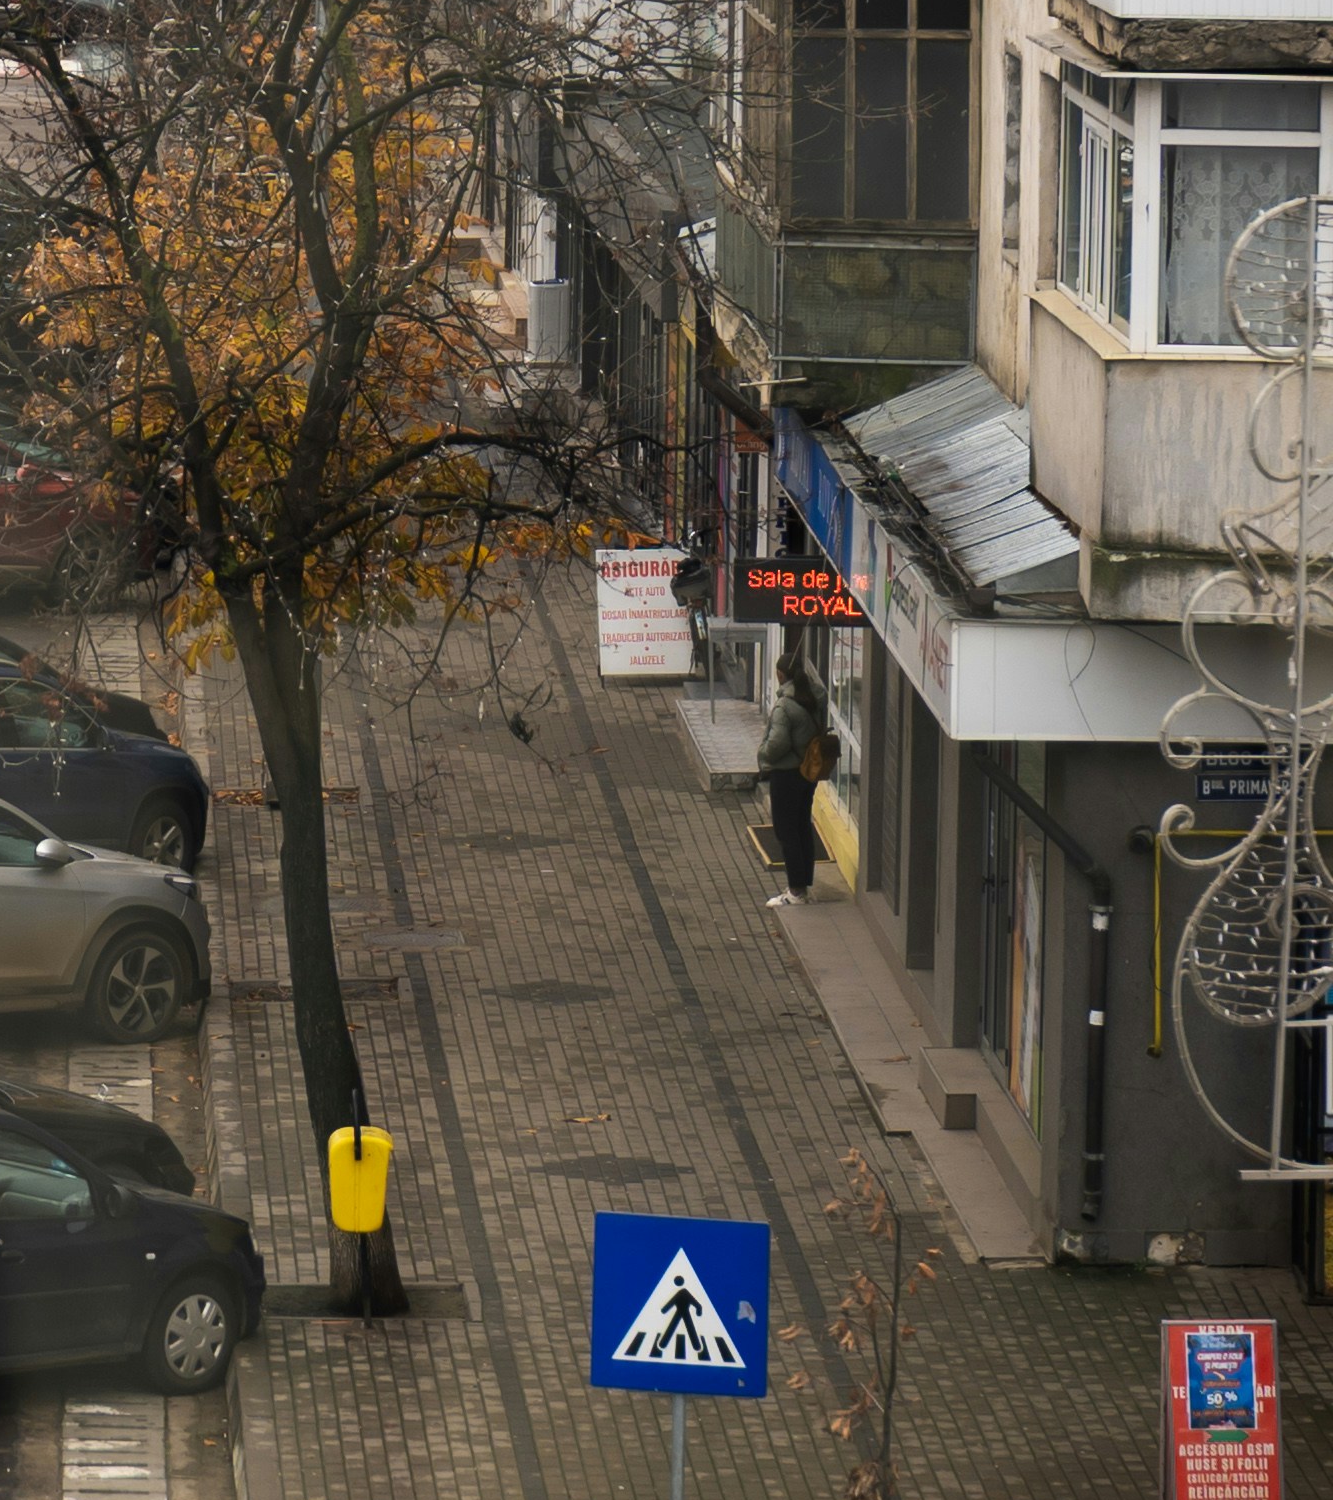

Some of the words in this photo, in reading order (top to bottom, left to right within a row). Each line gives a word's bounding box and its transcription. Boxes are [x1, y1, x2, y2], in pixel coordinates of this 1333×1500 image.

[748, 569, 795, 589] Sala
[802, 569, 830, 589] de
[645, 586, 665, 597] AUTO
[783, 595, 862, 616] ROYAL
[602, 609, 628, 621] DOSAR
[602, 632, 644, 643] TRADUCERI
[646, 631, 691, 642] AUTORIZATE
[630, 655, 665, 666] JALUZELE
[1206, 1393, 1223, 1405] 50
[1225, 1391, 1238, 1402] %
[1178, 1443, 1243, 1457] ACCESORII
[1247, 1443, 1275, 1456] GSM
[1186, 1457, 1218, 1471] HUSE
[1222, 1458, 1234, 1473] ȘI
[1237, 1457, 1268, 1470] FOLII
[1187, 1471, 1269, 1484] (SILICON/STICLĂ)
[1188, 1484, 1269, 1500] REÎNCĂRCĂRI
